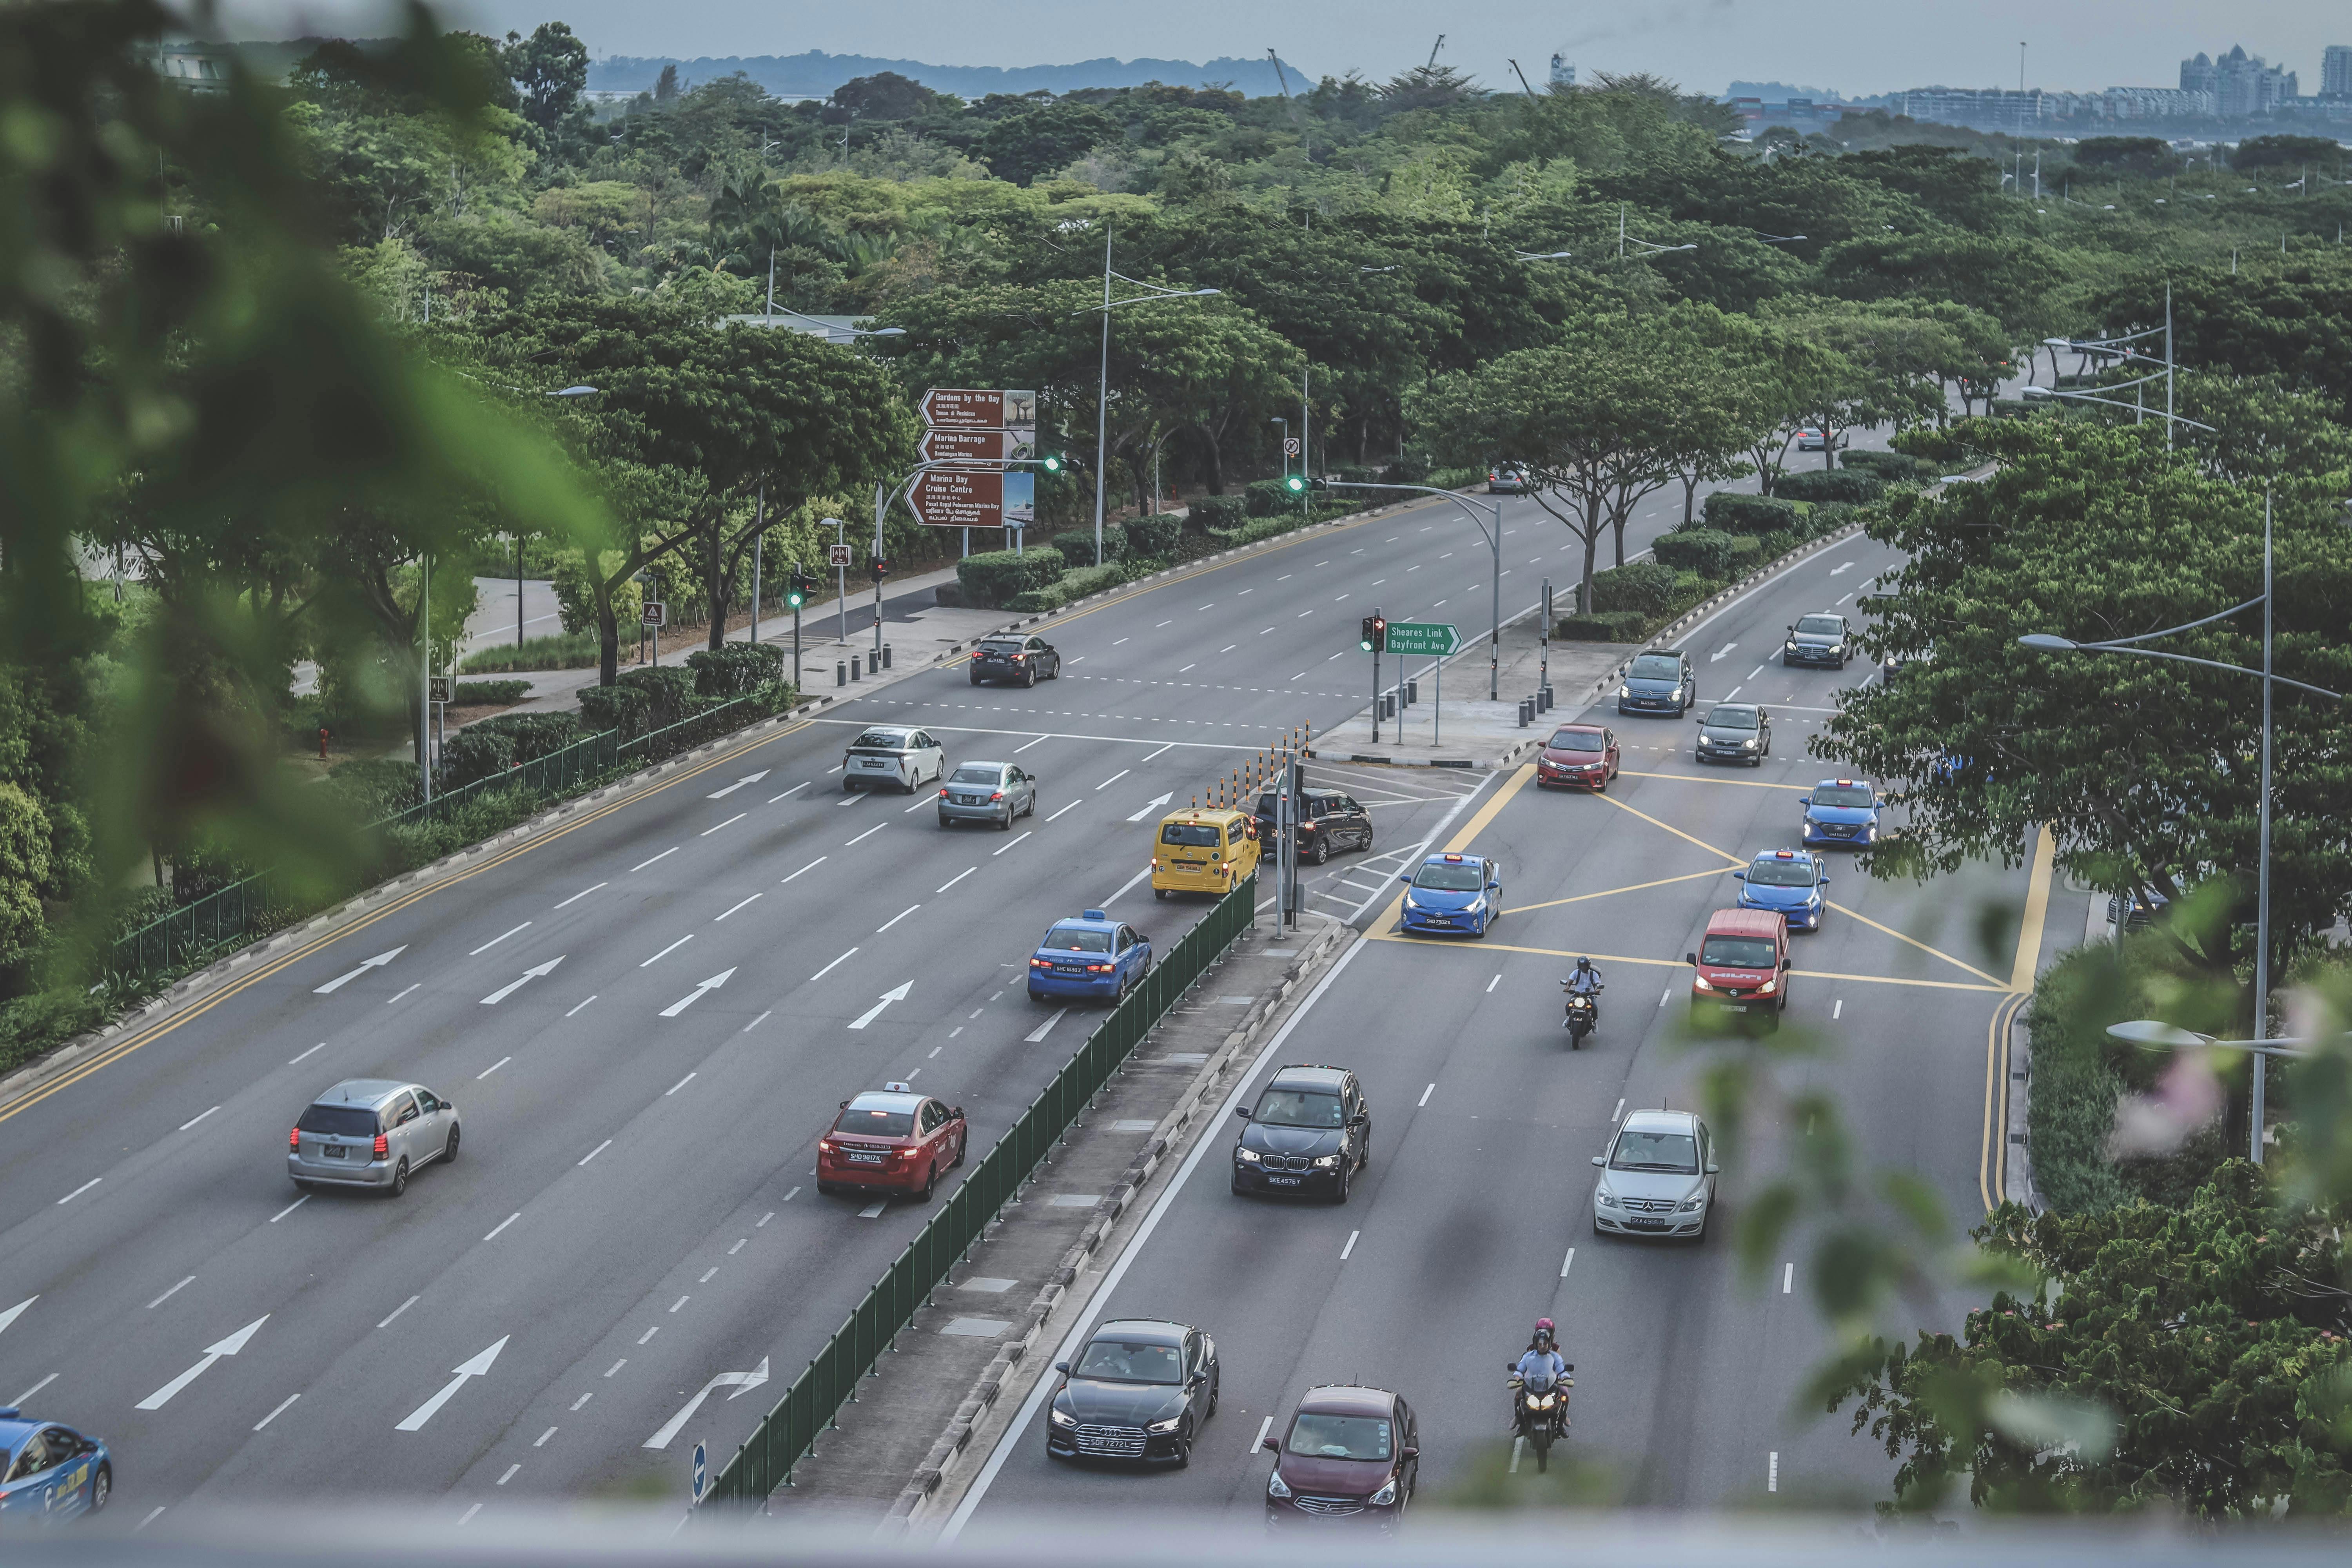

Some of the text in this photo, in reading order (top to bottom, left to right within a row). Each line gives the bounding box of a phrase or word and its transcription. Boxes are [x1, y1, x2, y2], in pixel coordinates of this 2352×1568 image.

[964, 394, 971, 403] by
[988, 394, 1000, 404] Bay
[959, 434, 985, 444] Barrage
[930, 474, 968, 485] Marina Bay
[950, 485, 973, 493] Centre
[1392, 627, 1442, 637] Sheares Link
[1392, 639, 1445, 651] Bayfront Ave
